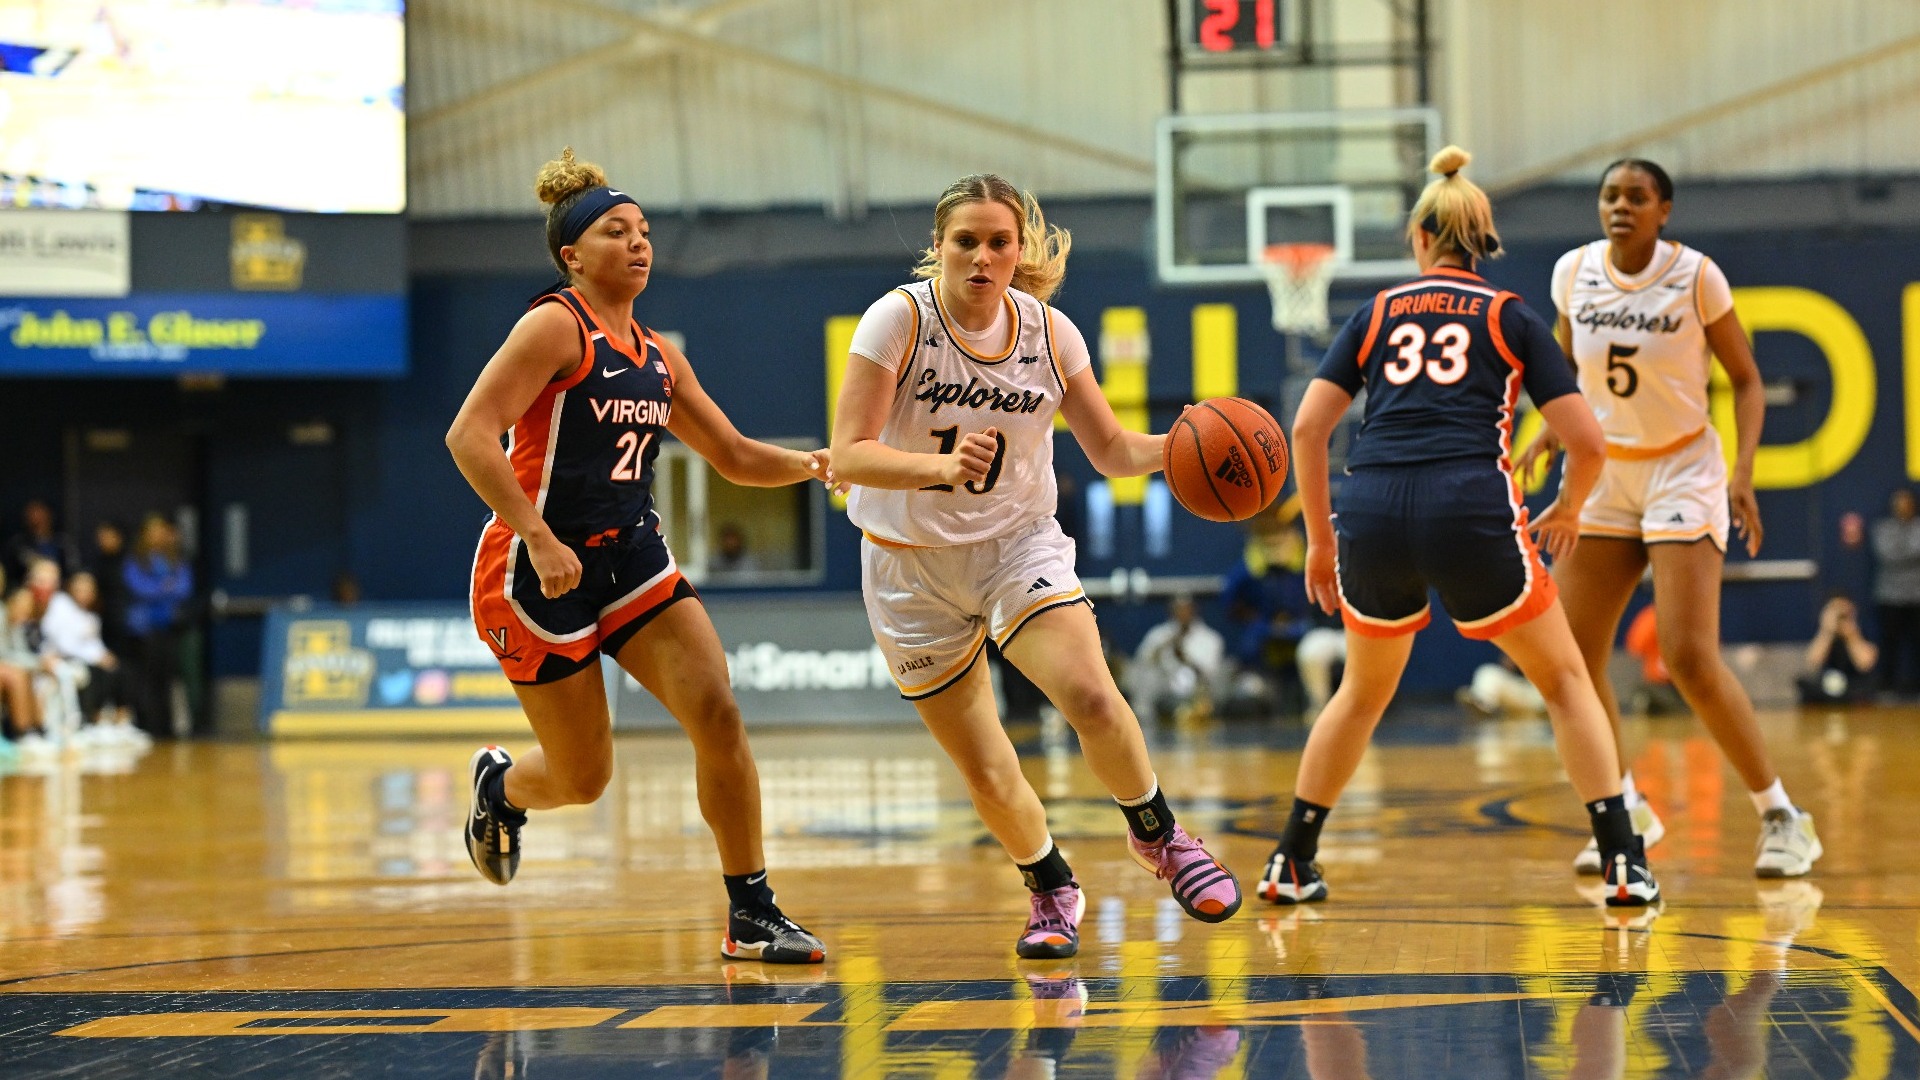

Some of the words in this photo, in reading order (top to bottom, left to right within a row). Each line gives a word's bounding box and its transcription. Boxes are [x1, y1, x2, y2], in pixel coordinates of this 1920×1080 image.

[1201, 0, 1275, 51] 21
[1388, 291, 1484, 318] BRUNELLE
[1575, 302, 1683, 335] Explorers
[1383, 321, 1472, 386] 33
[1606, 342, 1640, 399] 5
[915, 367, 1046, 415] Explorers
[610, 430, 655, 482] 21
[1228, 445, 1253, 488] adidas
[905, 655, 935, 671] SALLE
